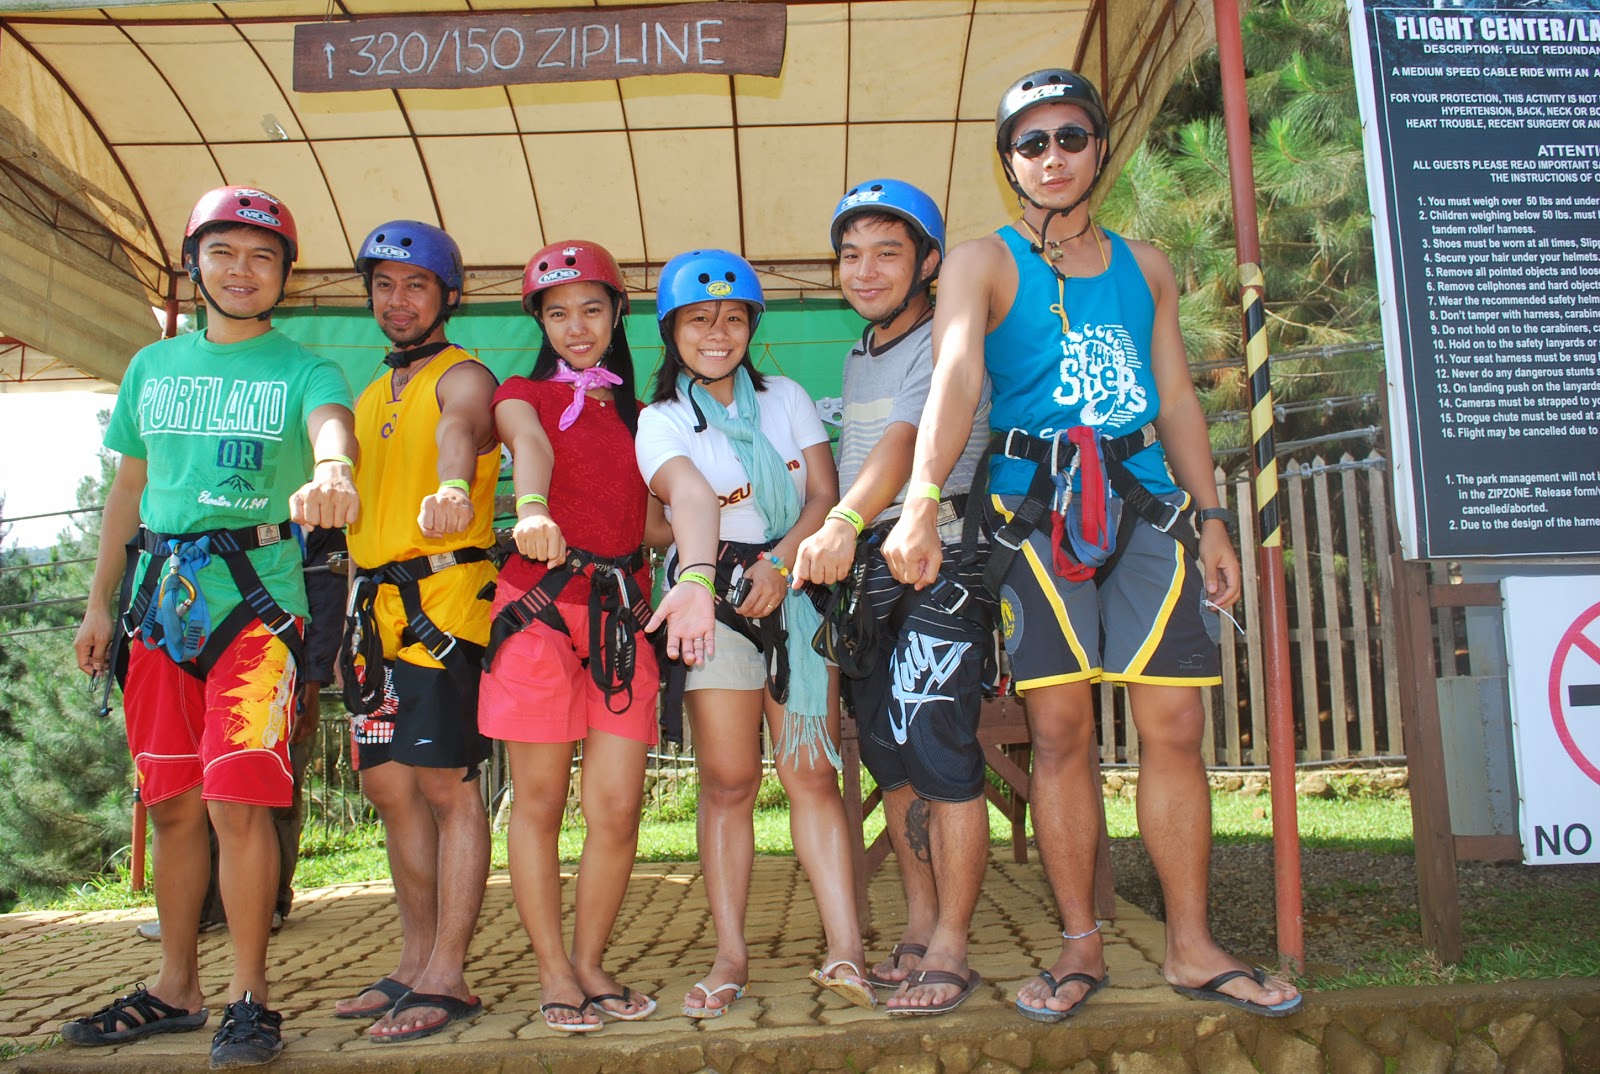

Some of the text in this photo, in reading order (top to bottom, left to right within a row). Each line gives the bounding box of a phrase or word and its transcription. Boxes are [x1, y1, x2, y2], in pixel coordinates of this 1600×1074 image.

[1395, 16, 1473, 40] FLIGHT
[348, 19, 724, 76] 320/150 ZIPLINE
[1423, 44, 1540, 54] DESCRIPTION: FULLY
[1391, 66, 1589, 77] A MEDIUM SPEED CABLE RIDE WITH AN
[1390, 93, 1597, 104] FOR YOUR PROTECTION, THIS ACTIVITY IS NOT
[1441, 106, 1588, 117] HYPERTENSION, BACK, NECK OR
[1405, 118, 1586, 129] HEART TROUBLE, RECENT SURGERY OR
[1537, 144, 1600, 157] ATTENTI
[1412, 160, 1590, 170] ALL GUESTS PLEASE READ IMPORTANT
[1489, 172, 1592, 182] THE INSTRUCTIONS OF
[1427, 196, 1600, 208] You must weigh over 50 lbs and under
[1429, 209, 1596, 222] Children weighing below 50 lbs. must
[1431, 224, 1466, 234] tandem
[1496, 224, 1536, 234] harness.
[1432, 237, 1579, 249] Shoes must worn at all times,
[1434, 252, 1467, 263] Secure
[1468, 254, 1490, 265] your
[1491, 252, 1510, 262] hair
[1511, 252, 1538, 262] under
[1539, 253, 1561, 264] your
[1435, 266, 1578, 279] Remove all pointed objects and
[1437, 281, 1475, 291] Remove
[1476, 280, 1527, 293] cellphones
[1528, 280, 1546, 290] and
[1547, 280, 1569, 290] hard
[1438, 294, 1576, 306] Wear the recommended safety
[1440, 309, 1563, 322] Don't tamper with harness,
[1441, 323, 1591, 335] Do not hold the carabiners,
[1448, 337, 1597, 350] Hold the safety lanyards or
[1448, 352, 1596, 364] Your seat harness must snug
[1451, 366, 1595, 380] Never do any dangerous stunts
[1452, 380, 1600, 395] On landing push the lanyards
[139, 376, 288, 435] PORTLAND
[1454, 395, 1578, 408] Cameras must strapped
[1456, 410, 1594, 425] Drogue chute must used at
[1457, 425, 1586, 440] Flight may be cancelled due
[222, 440, 258, 470] OR
[1455, 471, 1596, 487] The park management will not
[1458, 487, 1572, 499] in the ZIPZONE. Release
[1461, 502, 1548, 515] cancelled/aborted.
[1460, 516, 1572, 530] Due the design of the
[1534, 823, 1592, 857] NO
